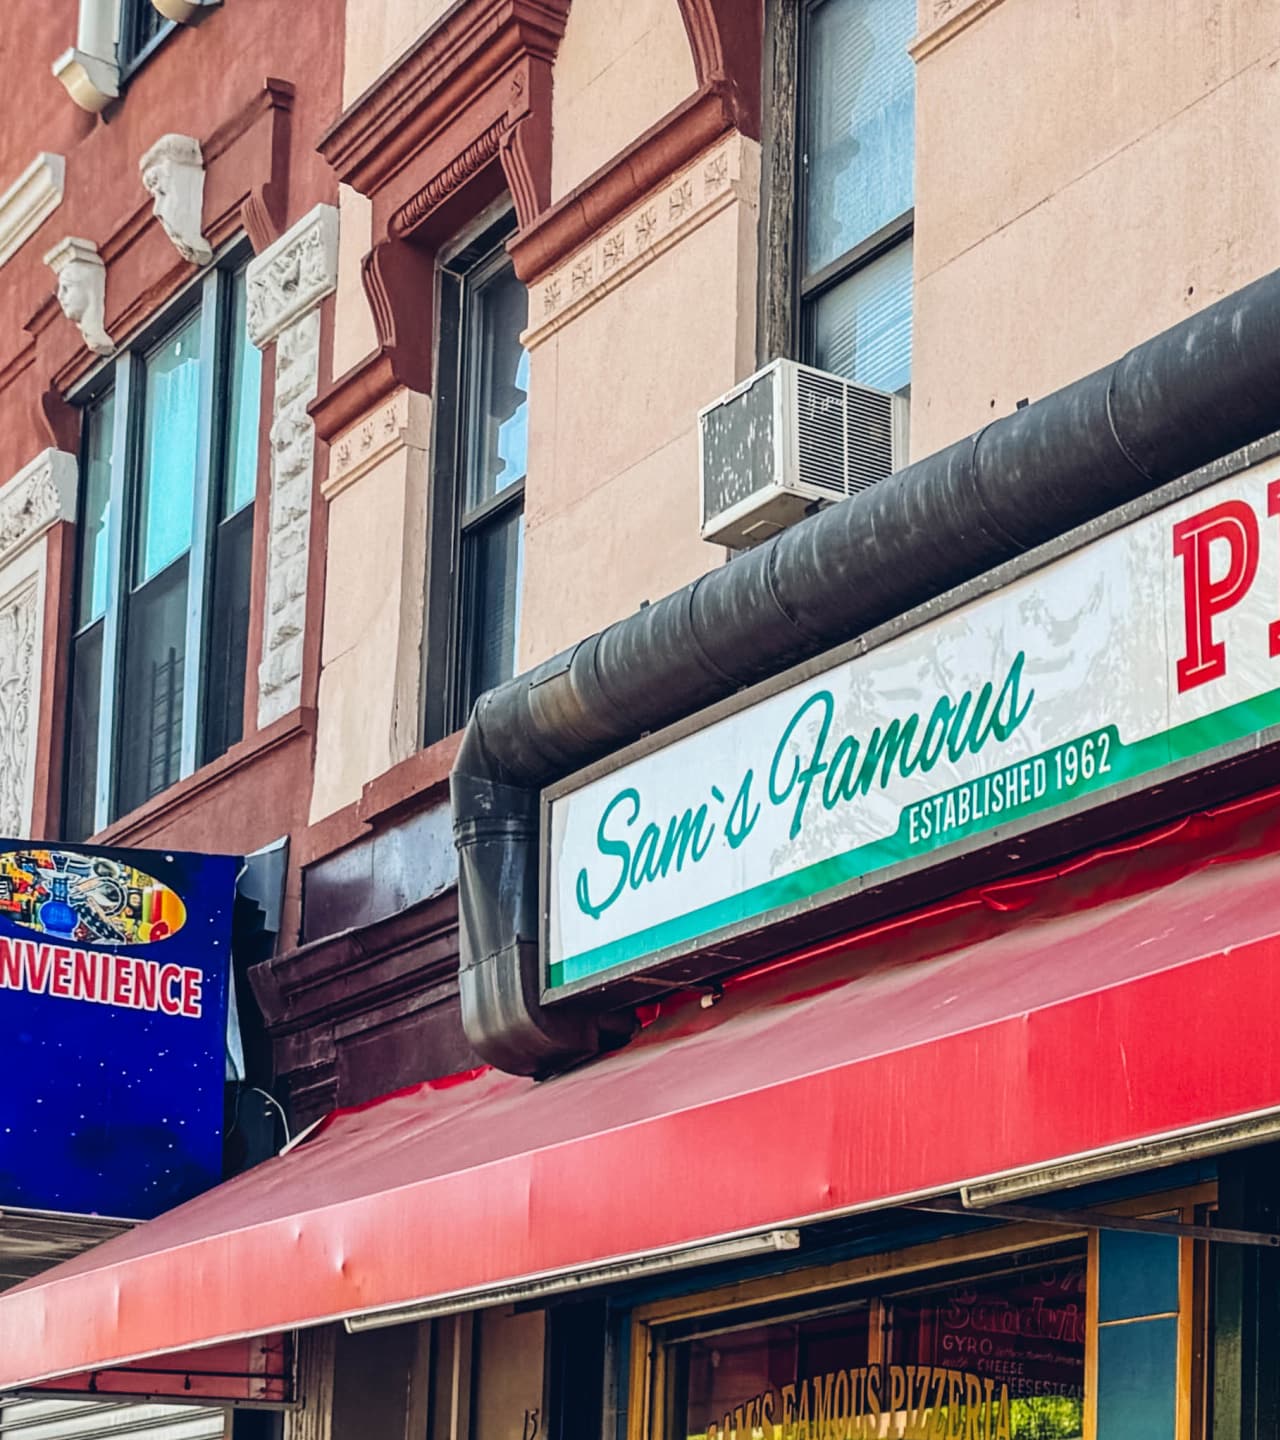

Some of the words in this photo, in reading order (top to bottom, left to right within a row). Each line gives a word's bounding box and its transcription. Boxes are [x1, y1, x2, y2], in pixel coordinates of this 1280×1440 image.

[576, 766, 760, 920] Sam's
[768, 651, 1034, 841] Famous
[906, 757, 1049, 846] ESTABLISHED
[1052, 732, 1113, 789] 1962
[943, 1335, 993, 1355] GYRO
[977, 1358, 1024, 1375] CHEESE
